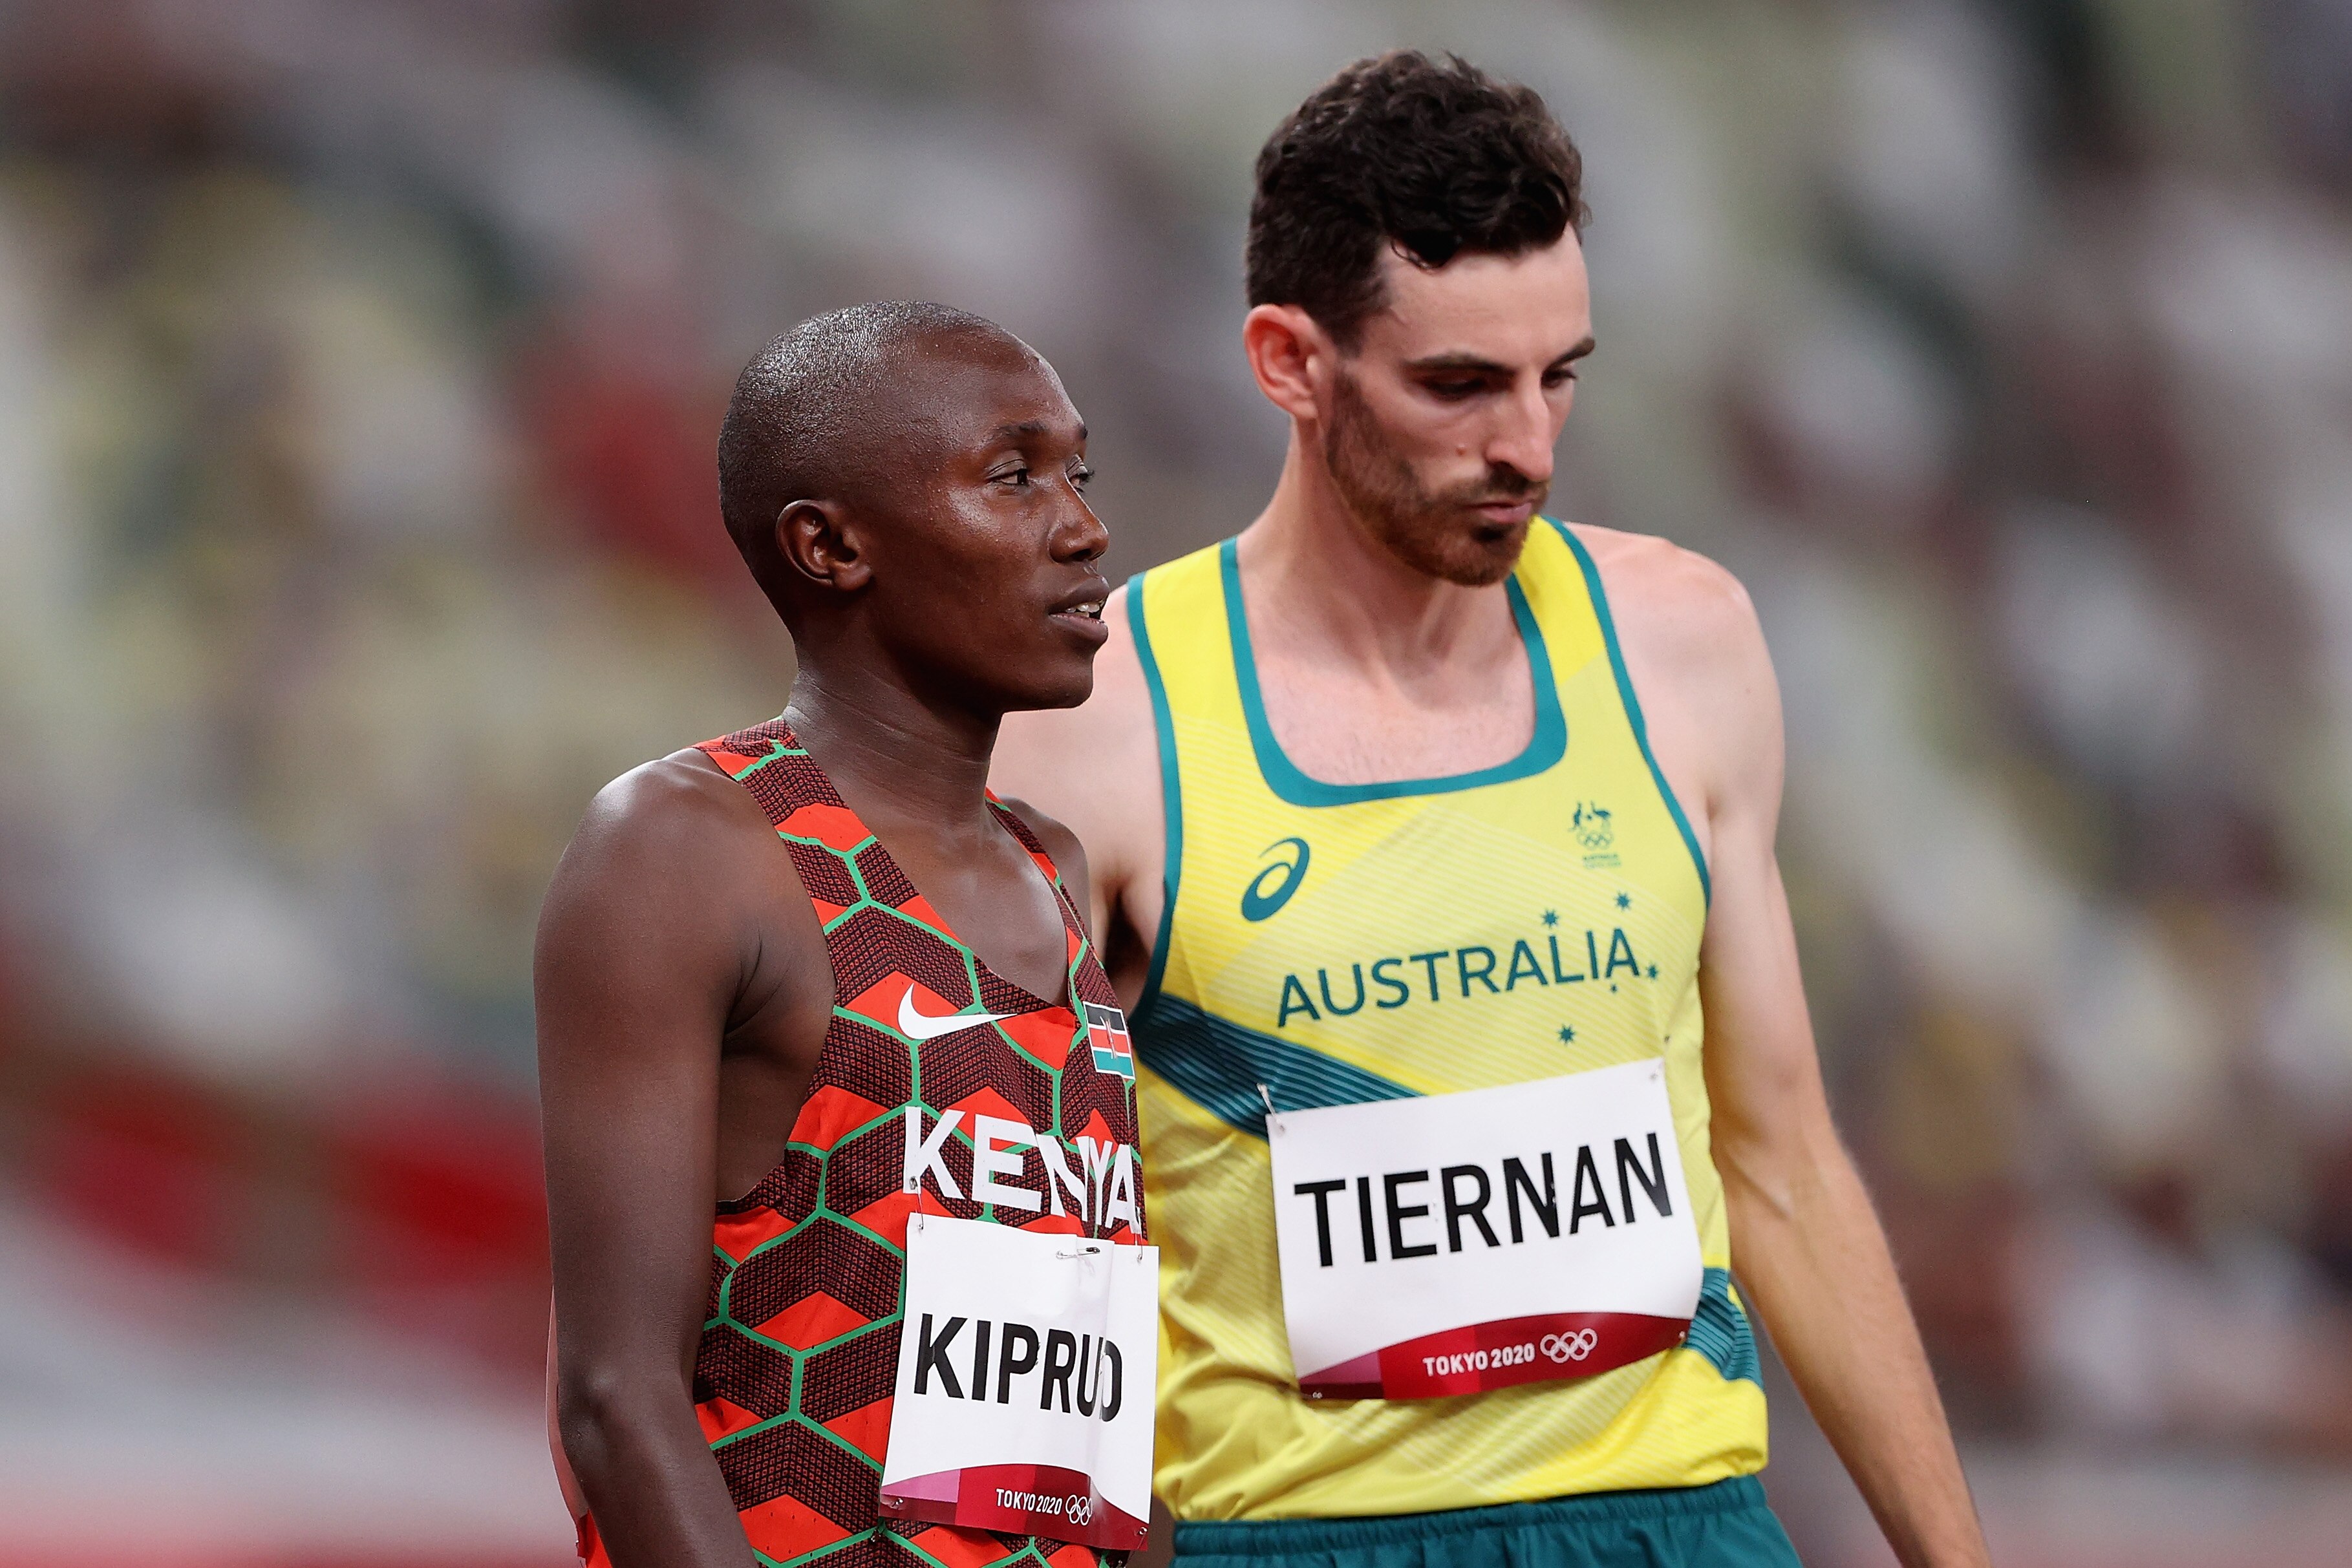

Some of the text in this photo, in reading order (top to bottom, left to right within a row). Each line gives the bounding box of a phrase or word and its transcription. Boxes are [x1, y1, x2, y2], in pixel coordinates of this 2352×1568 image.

[1278, 928, 1640, 1028] AUSTRALIA
[903, 1106, 1141, 1234] KENYA
[1294, 1132, 1673, 1267] TIERNAN
[914, 1313, 1122, 1423] KIPRUO
[1422, 1342, 1535, 1377] TOKYO 2020
[996, 1489, 1062, 1515] TOKYO 2020
